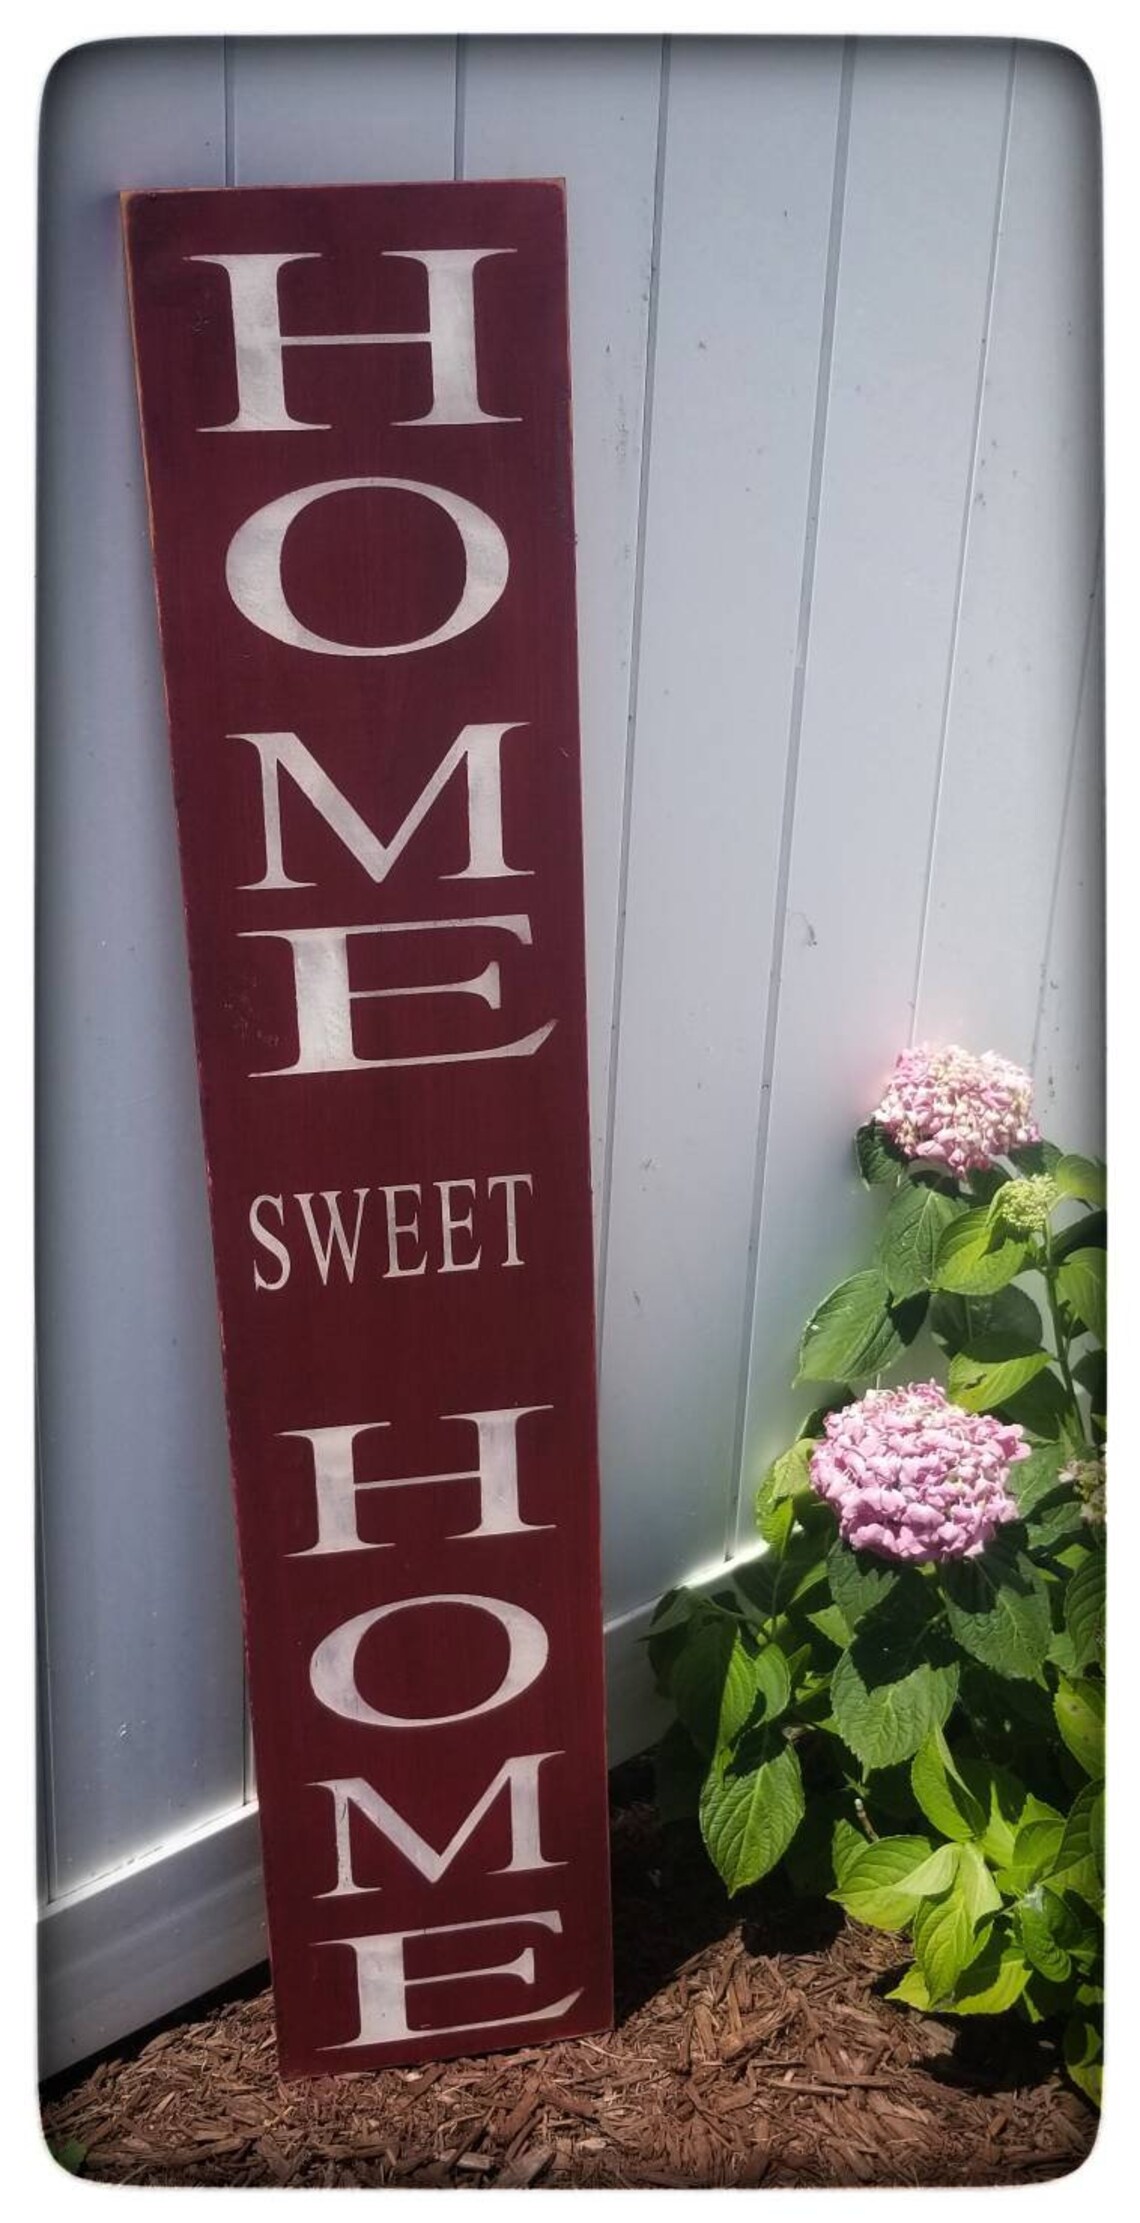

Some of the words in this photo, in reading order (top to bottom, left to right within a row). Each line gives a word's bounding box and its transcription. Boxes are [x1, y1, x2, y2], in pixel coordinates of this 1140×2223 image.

[183, 248, 557, 1079] HOME
[249, 1174, 533, 1291] SWEET
[279, 1404, 585, 2050] HOME
